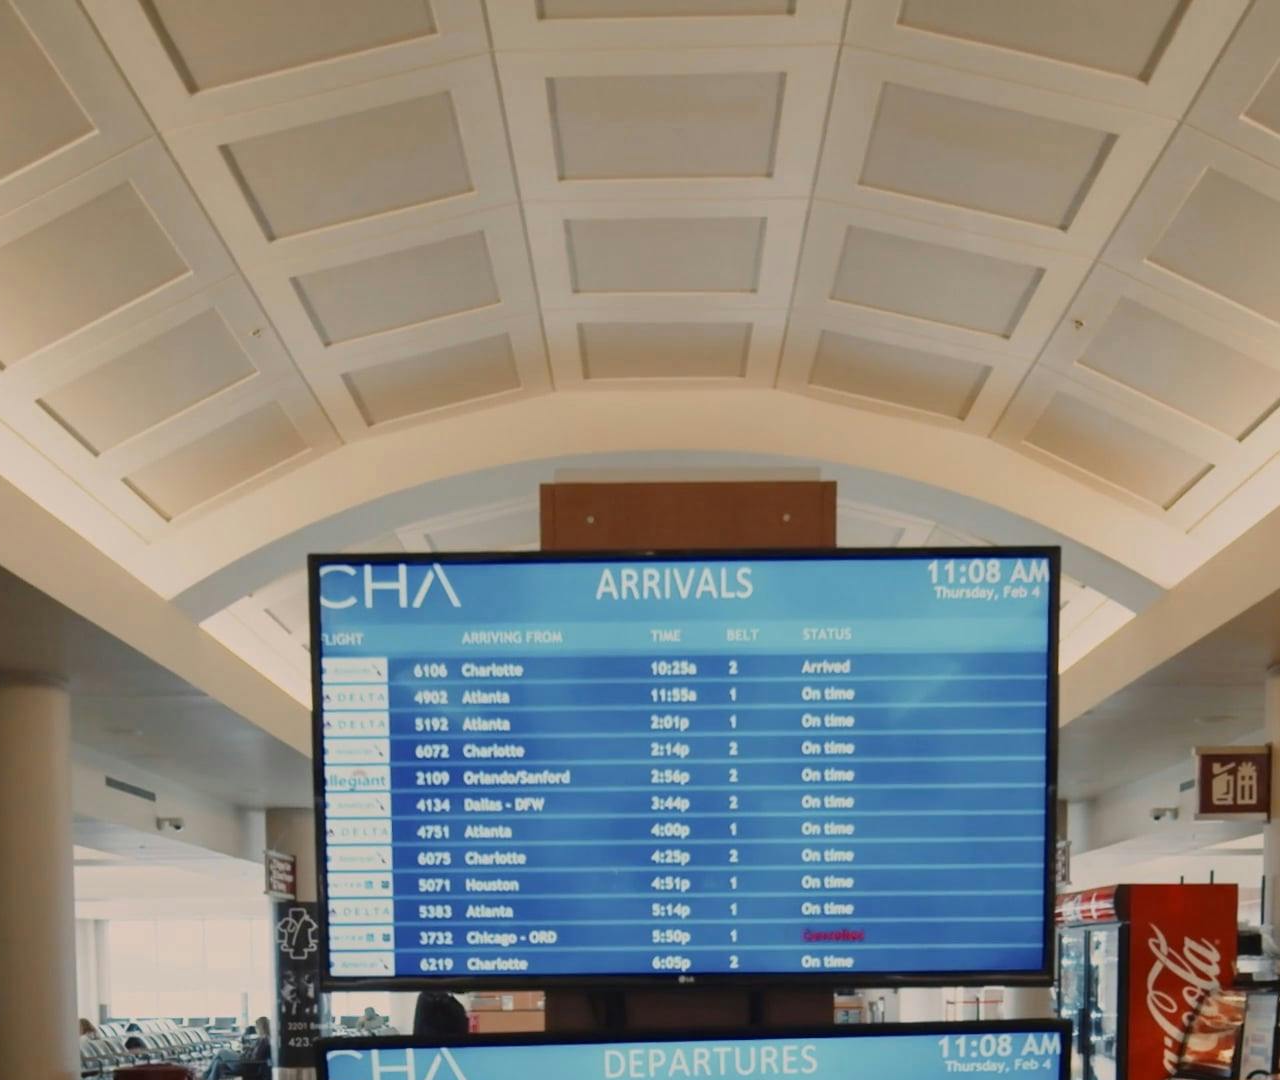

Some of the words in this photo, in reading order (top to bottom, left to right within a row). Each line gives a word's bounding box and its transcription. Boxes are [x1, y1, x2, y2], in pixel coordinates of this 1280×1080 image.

[928, 560, 1001, 583] 11:08
[1011, 560, 1048, 583] AM
[319, 563, 461, 608] CHA
[597, 567, 753, 599] ARRIVALS
[934, 585, 999, 601] Thursday,
[1003, 585, 1029, 599] Feb
[1031, 586, 1041, 598] 4
[462, 631, 523, 644] ARRIVING
[525, 630, 563, 644] FROM
[651, 629, 681, 642] TIME
[726, 628, 759, 641] BELT
[802, 627, 852, 641] STATUS
[413, 663, 448, 678] 6106
[461, 662, 524, 678] Charlotte
[651, 660, 698, 676] 10:25a
[728, 660, 738, 675] 2
[801, 659, 851, 674] Arrived
[337, 692, 385, 702] DELTA
[461, 690, 511, 705] Atlanta
[651, 687, 697, 702] 11:55a
[729, 687, 737, 702] 1
[801, 686, 822, 701] On
[823, 686, 855, 701] time
[337, 719, 386, 729] DELTA
[414, 716, 449, 732] 5192
[462, 717, 511, 731] Atlanta
[650, 714, 690, 732] 2:01p
[801, 713, 822, 728] On
[823, 714, 855, 728] time
[415, 743, 450, 759] 6072
[462, 743, 526, 758] Charlotte
[650, 742, 690, 759] 2:14p
[801, 740, 822, 755] On
[823, 741, 855, 755] time
[463, 770, 571, 785] Orlando/Sanford
[650, 768, 690, 786] 2:56p
[801, 767, 822, 782] On
[823, 768, 855, 782] time
[416, 798, 451, 813] 4134
[464, 798, 503, 812] Dallas
[514, 797, 545, 812] DFW
[651, 796, 690, 813] 3:44p
[416, 824, 450, 839] 4751
[464, 825, 513, 839] Atlanta
[650, 822, 691, 839] 4:00p
[417, 851, 452, 866] 6075
[464, 851, 527, 865] Charlotte
[650, 849, 691, 866] 4:25p
[418, 878, 451, 893] 5071
[465, 878, 520, 892] Houston
[651, 876, 691, 893] 4:51p
[418, 904, 453, 919] 5383
[465, 904, 514, 918] Atlanta
[651, 903, 691, 919] 5:14p
[419, 931, 454, 945] 3732
[466, 931, 518, 947] Chicago
[528, 930, 558, 944] ORD
[652, 929, 691, 946] 5:50p
[419, 957, 454, 972] 6219
[466, 957, 529, 971] Charlotte
[651, 955, 692, 972] 6:05p
[939, 1035, 1012, 1057] 11:08
[1021, 1035, 1059, 1055] AM
[605, 1045, 817, 1078] DEPARTURES
[944, 1059, 1010, 1074] Thursday,
[1014, 1058, 1039, 1070] Feb
[1042, 1059, 1051, 1069] 4
